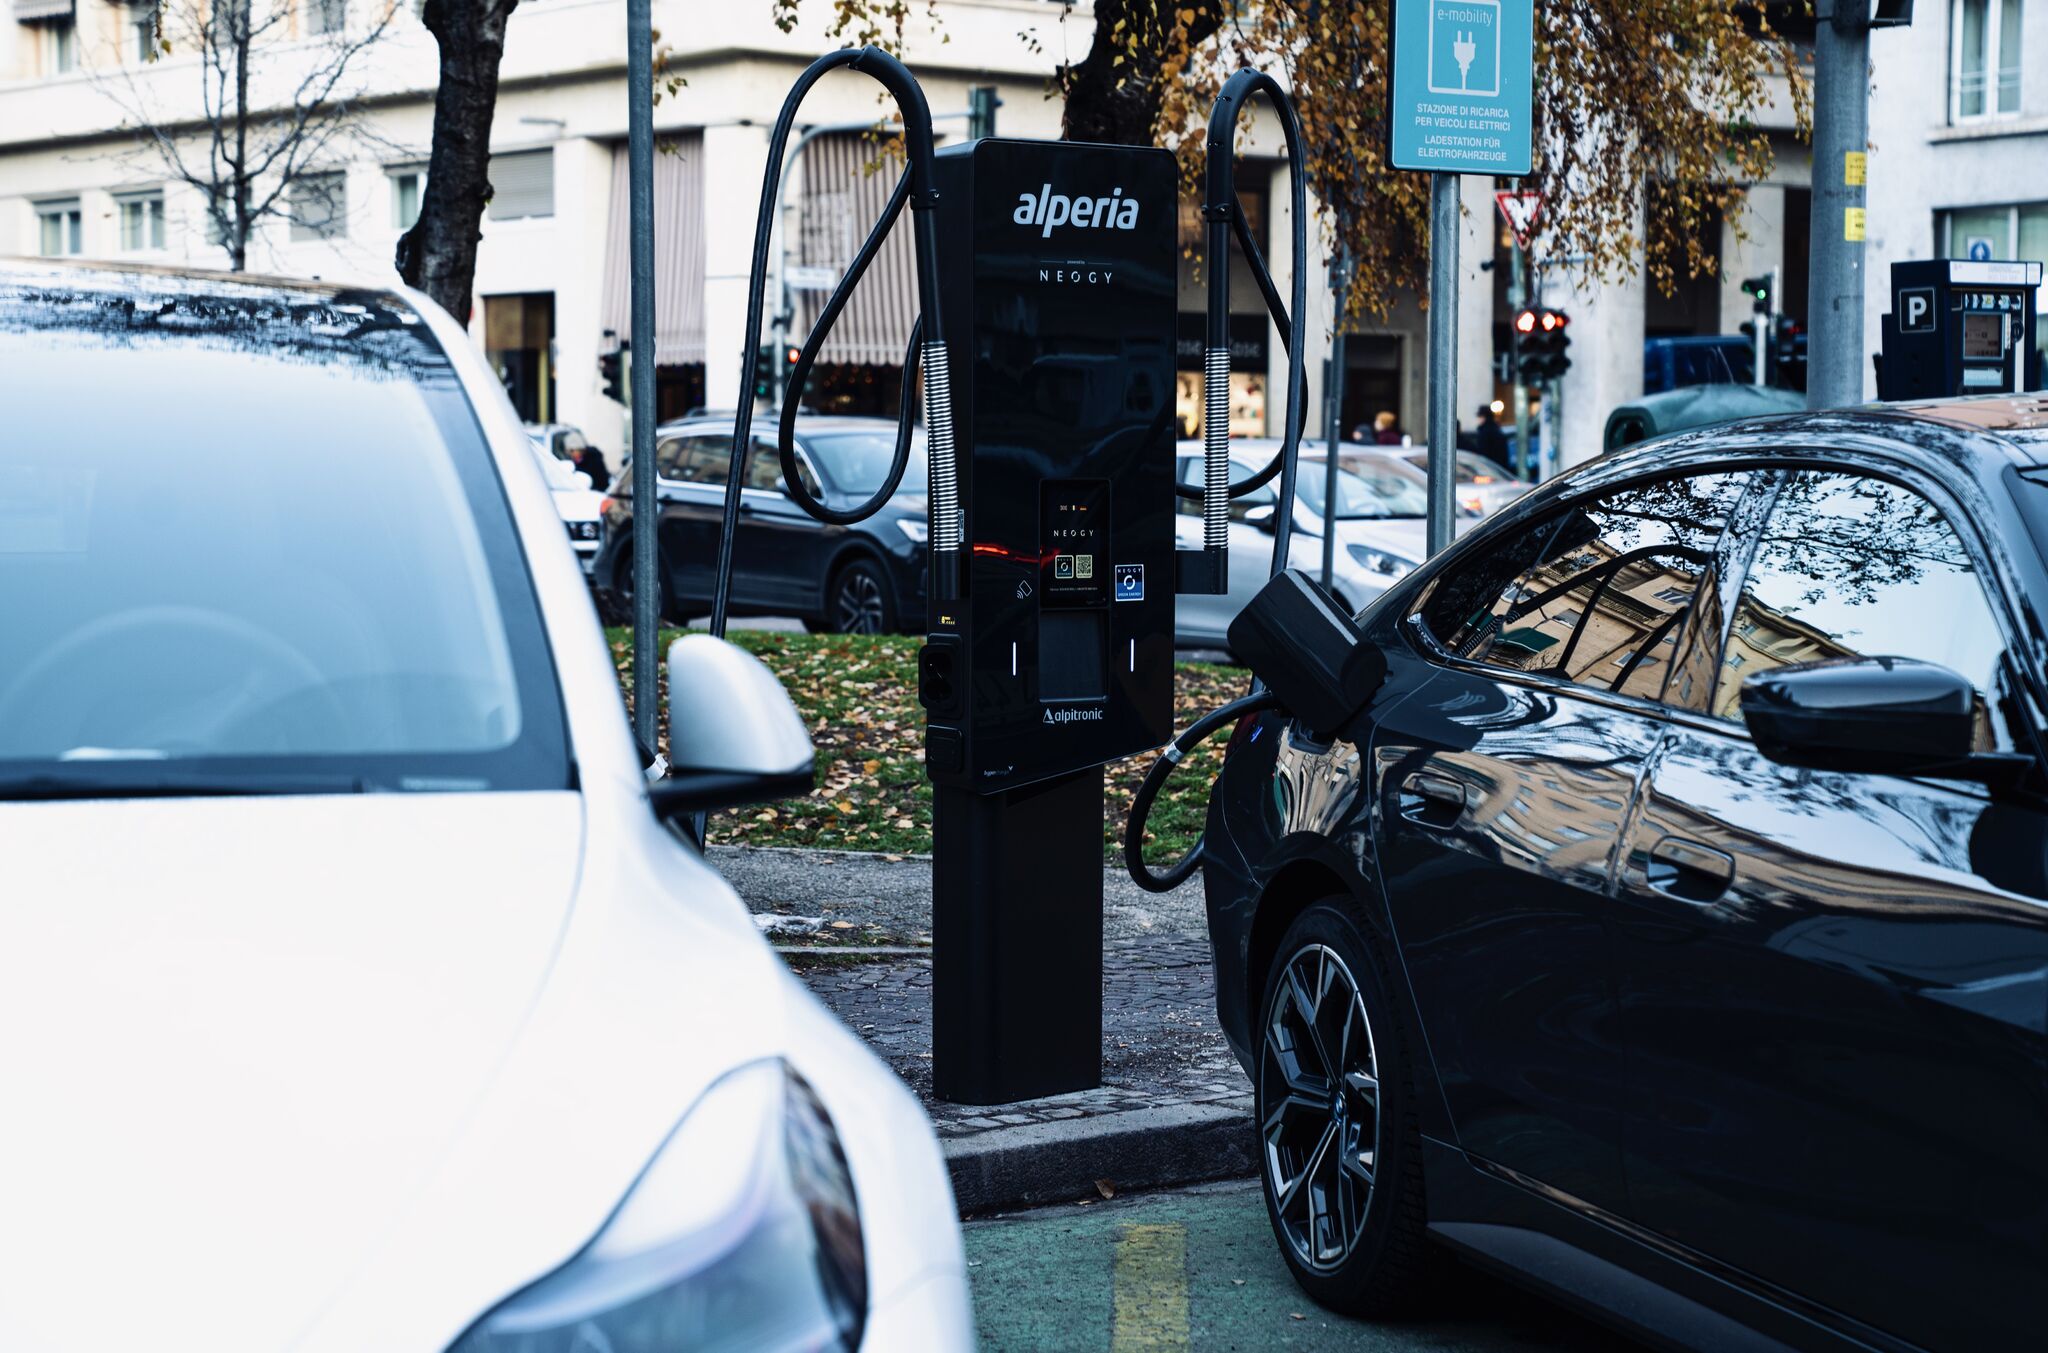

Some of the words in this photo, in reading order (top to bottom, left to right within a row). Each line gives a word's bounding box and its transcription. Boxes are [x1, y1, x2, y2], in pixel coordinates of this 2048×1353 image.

[1437, 8, 1493, 27] e-mobility
[1417, 103, 1458, 115] STAZIONE
[1460, 106, 1468, 116] DI
[1470, 106, 1509, 118] RICARICA
[1415, 116, 1432, 126] PER
[1434, 118, 1467, 129] VEICOLI
[1468, 119, 1511, 131] ELETTRICI
[1424, 135, 1482, 148] LADESTATION
[1483, 137, 1501, 149] FÜR
[1418, 147, 1507, 161] ELEKTROFAHRZEUGE
[1013, 183, 1140, 238] alperia
[1040, 269, 1112, 284] NEOGY
[1908, 296, 1927, 326] P
[1053, 529, 1094, 537] NEOGY
[1054, 707, 1103, 724] alpitronic
